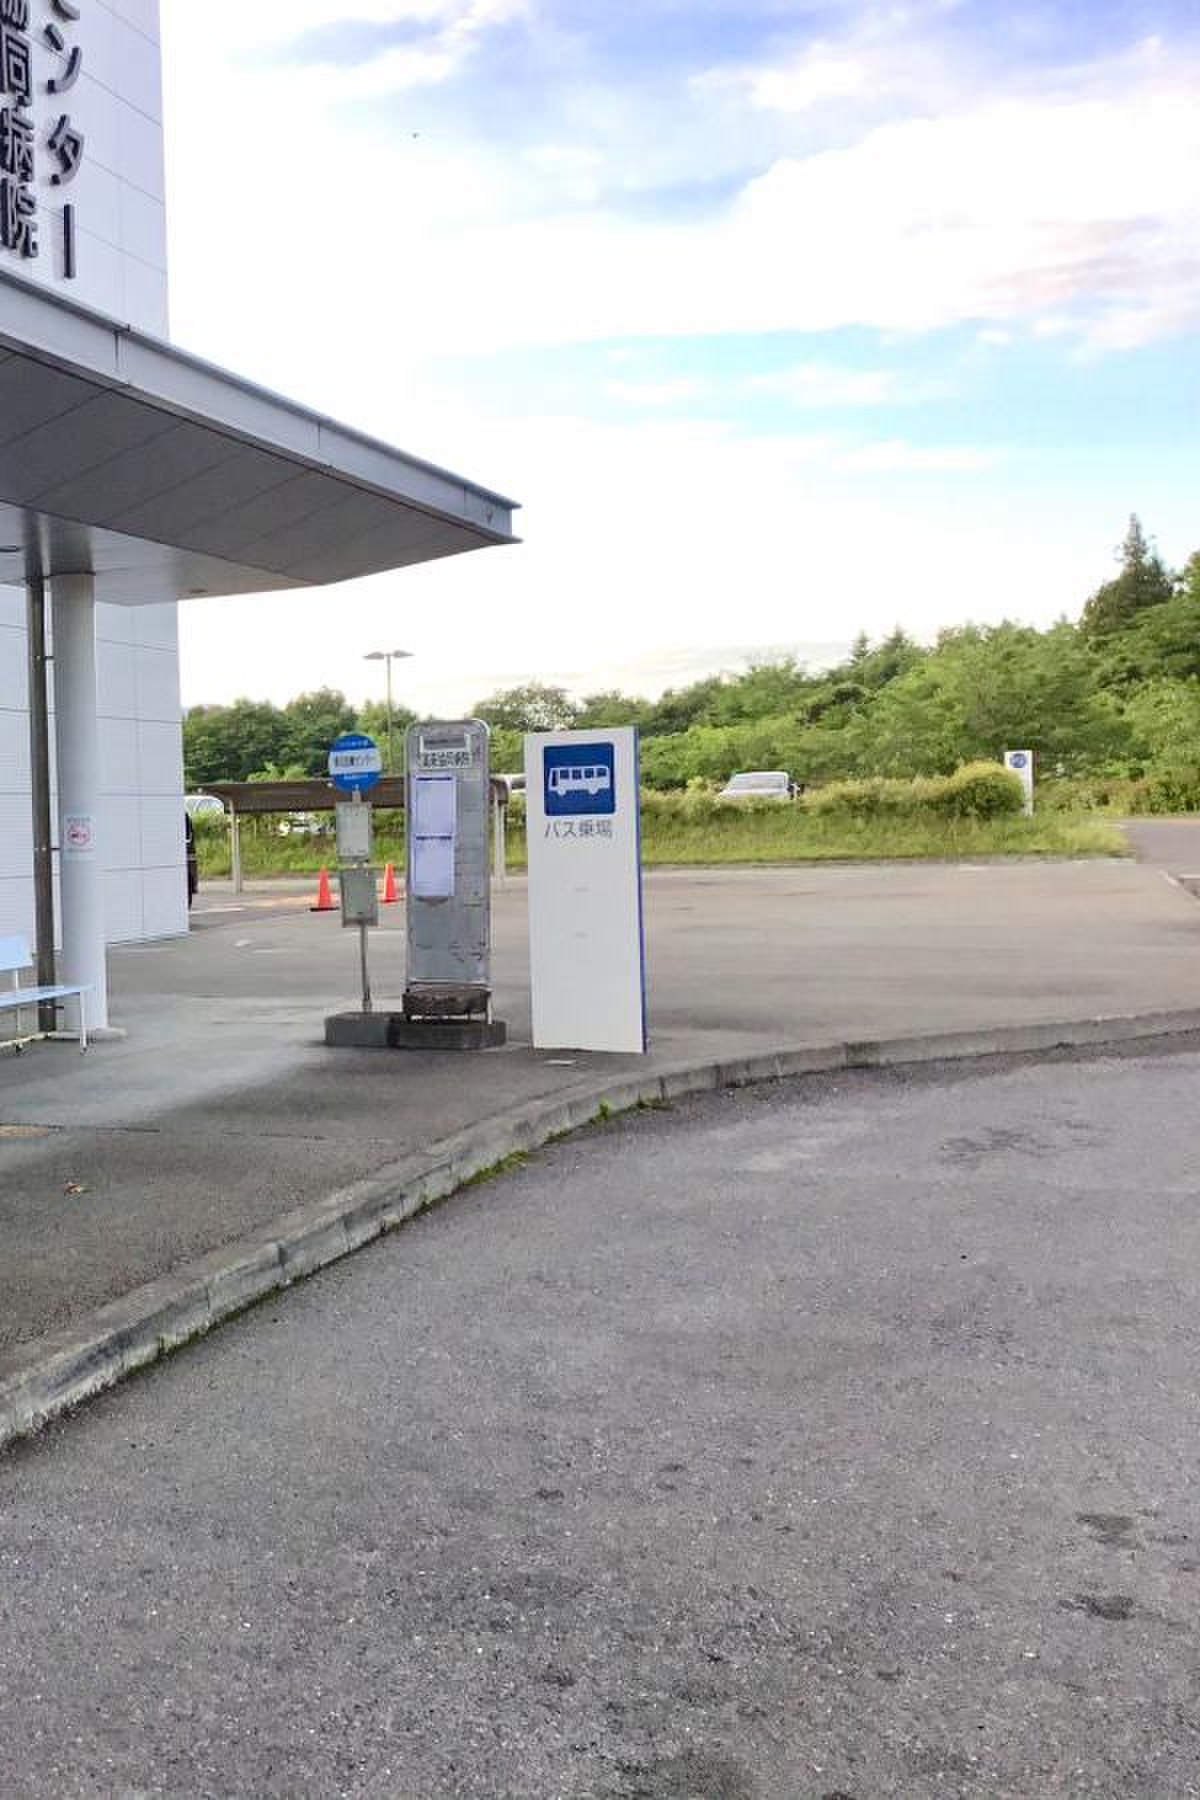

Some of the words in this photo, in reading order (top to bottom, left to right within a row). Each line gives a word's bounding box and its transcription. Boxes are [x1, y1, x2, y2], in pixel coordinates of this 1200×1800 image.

[44, 0, 84, 279] ンター
[544, 820, 613, 839] バス乗場
